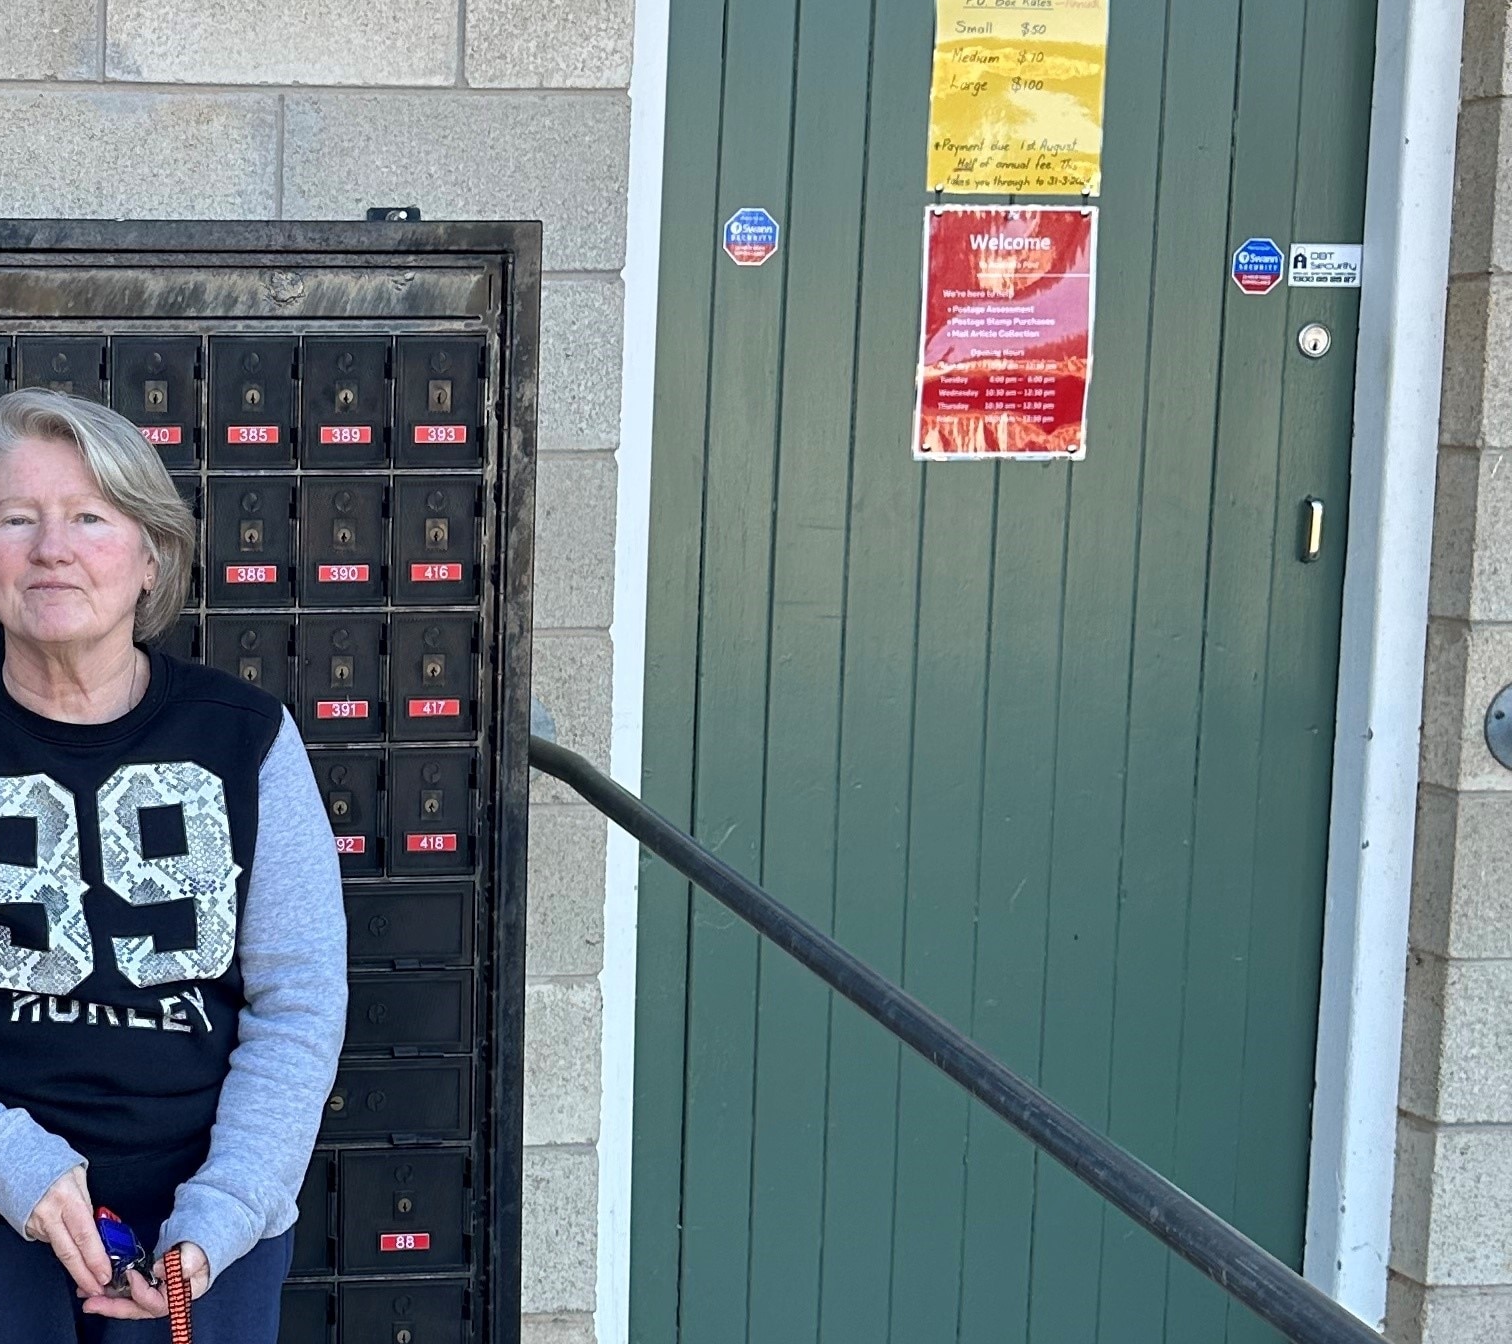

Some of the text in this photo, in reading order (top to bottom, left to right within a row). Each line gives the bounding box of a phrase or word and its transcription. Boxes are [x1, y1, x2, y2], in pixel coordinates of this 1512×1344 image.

[955, 20, 1047, 36] Small $50
[952, 47, 1000, 64] Medium
[950, 74, 1044, 96] Large $100
[970, 233, 1051, 250] Welcome
[239, 427, 268, 442] 385
[331, 427, 361, 442] 389
[427, 426, 456, 442] 393
[237, 566, 266, 582] 386
[329, 565, 359, 581] 390
[424, 565, 449, 580] 416
[331, 703, 356, 717] 391
[422, 700, 446, 716] 417
[336, 837, 355, 852] 92
[419, 836, 444, 851] 418
[395, 1234, 415, 1250] 88
